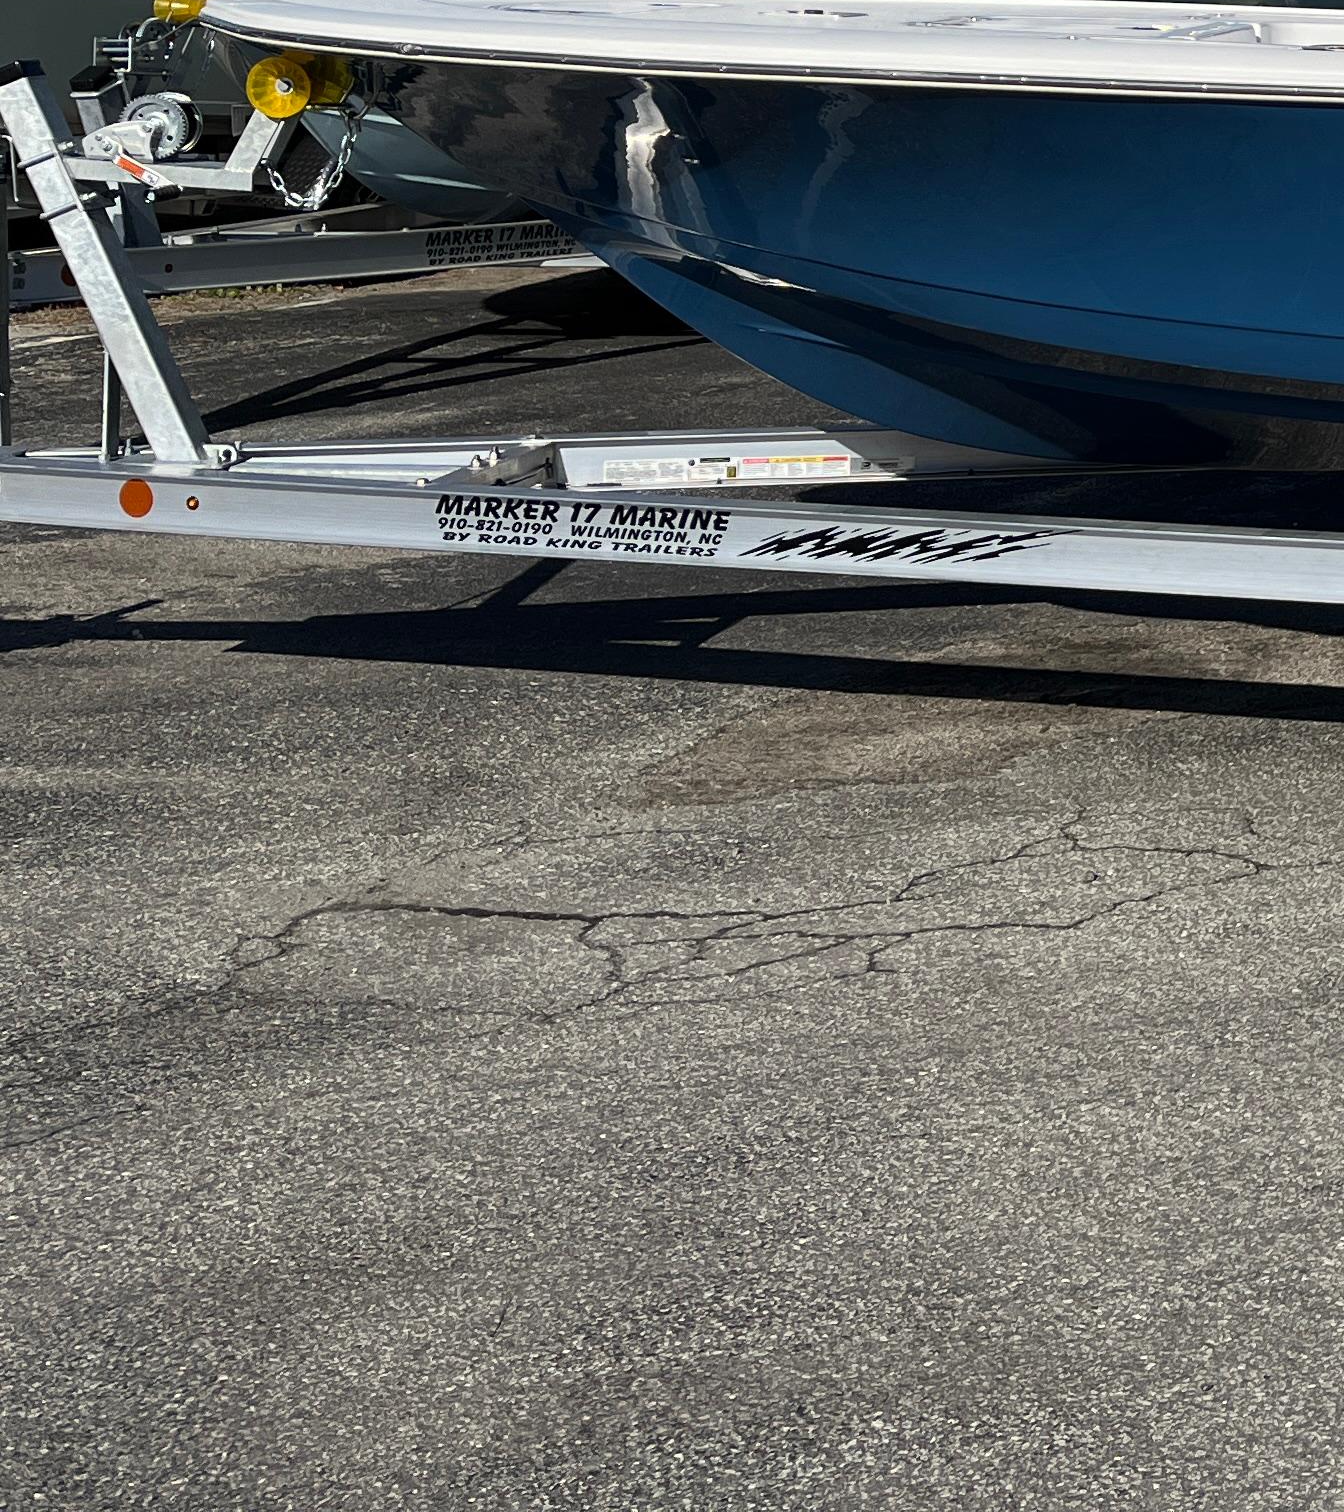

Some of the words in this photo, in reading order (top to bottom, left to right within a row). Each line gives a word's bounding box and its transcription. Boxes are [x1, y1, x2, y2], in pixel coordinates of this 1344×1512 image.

[426, 229, 494, 248] MARKER
[499, 227, 515, 242] 17
[435, 494, 561, 523] MARKER
[570, 502, 602, 524] 17
[609, 504, 732, 532] MARINE
[438, 517, 553, 535] 910-821-0190
[571, 524, 692, 545] WILMINGTON,
[699, 533, 724, 545] NC
[442, 531, 471, 542] BY
[478, 533, 538, 546] ROAD
[546, 537, 603, 550] KING
[611, 541, 719, 557] TRAILERS
